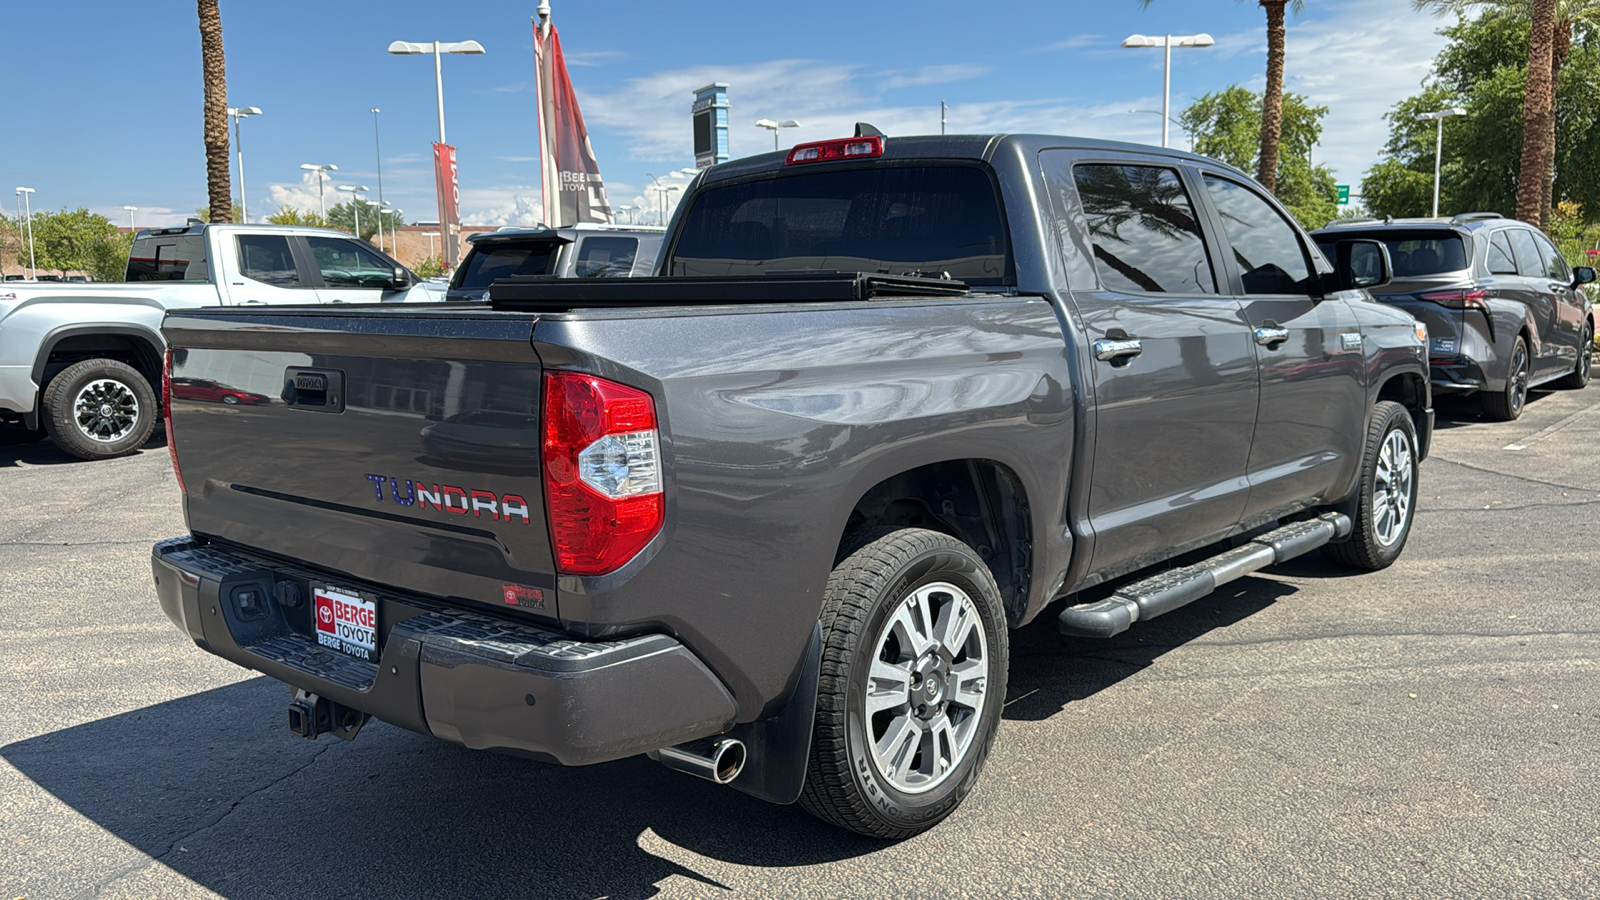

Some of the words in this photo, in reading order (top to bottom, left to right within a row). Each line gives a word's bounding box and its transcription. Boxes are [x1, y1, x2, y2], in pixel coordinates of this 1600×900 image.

[296, 377, 322, 389] TOYOTA
[364, 473, 531, 525] TUNDRA
[335, 600, 375, 628] BERGE
[517, 596, 545, 610] TOYOTA
[318, 633, 341, 650] BERGE
[342, 642, 370, 660] TOYOTA
[336, 623, 375, 645] TOYOTA
[857, 756, 878, 797] STR
